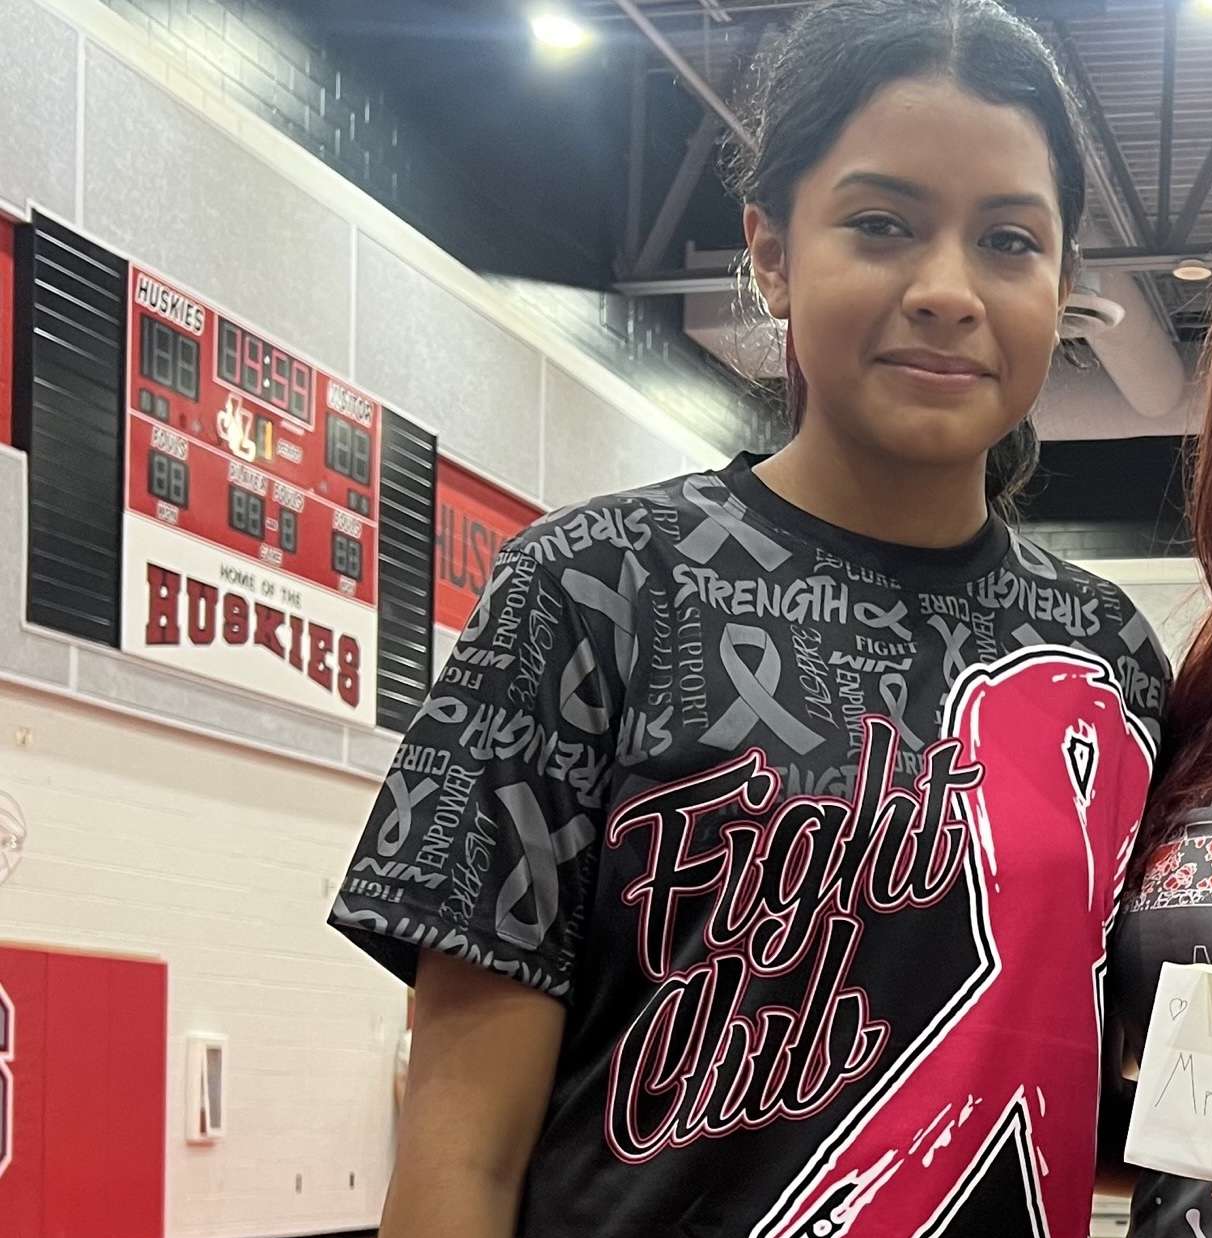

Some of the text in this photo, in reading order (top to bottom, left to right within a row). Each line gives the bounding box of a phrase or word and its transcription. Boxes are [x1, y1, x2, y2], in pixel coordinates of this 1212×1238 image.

[137, 277, 203, 333] HUSKIES
[436, 503, 498, 596] HUS
[219, 561, 302, 609] HOME OF THE
[673, 563, 848, 625] STRENGTH
[919, 592, 970, 623] CURE
[145, 561, 361, 709] HUSKIES
[828, 650, 913, 673] WIN
[855, 634, 918, 656] FIGHT
[677, 606, 710, 729] SUPPORT
[415, 764, 486, 869] ENPOWER
[608, 713, 985, 979] Fight
[352, 856, 448, 890] WIN
[605, 917, 891, 1163] Club
